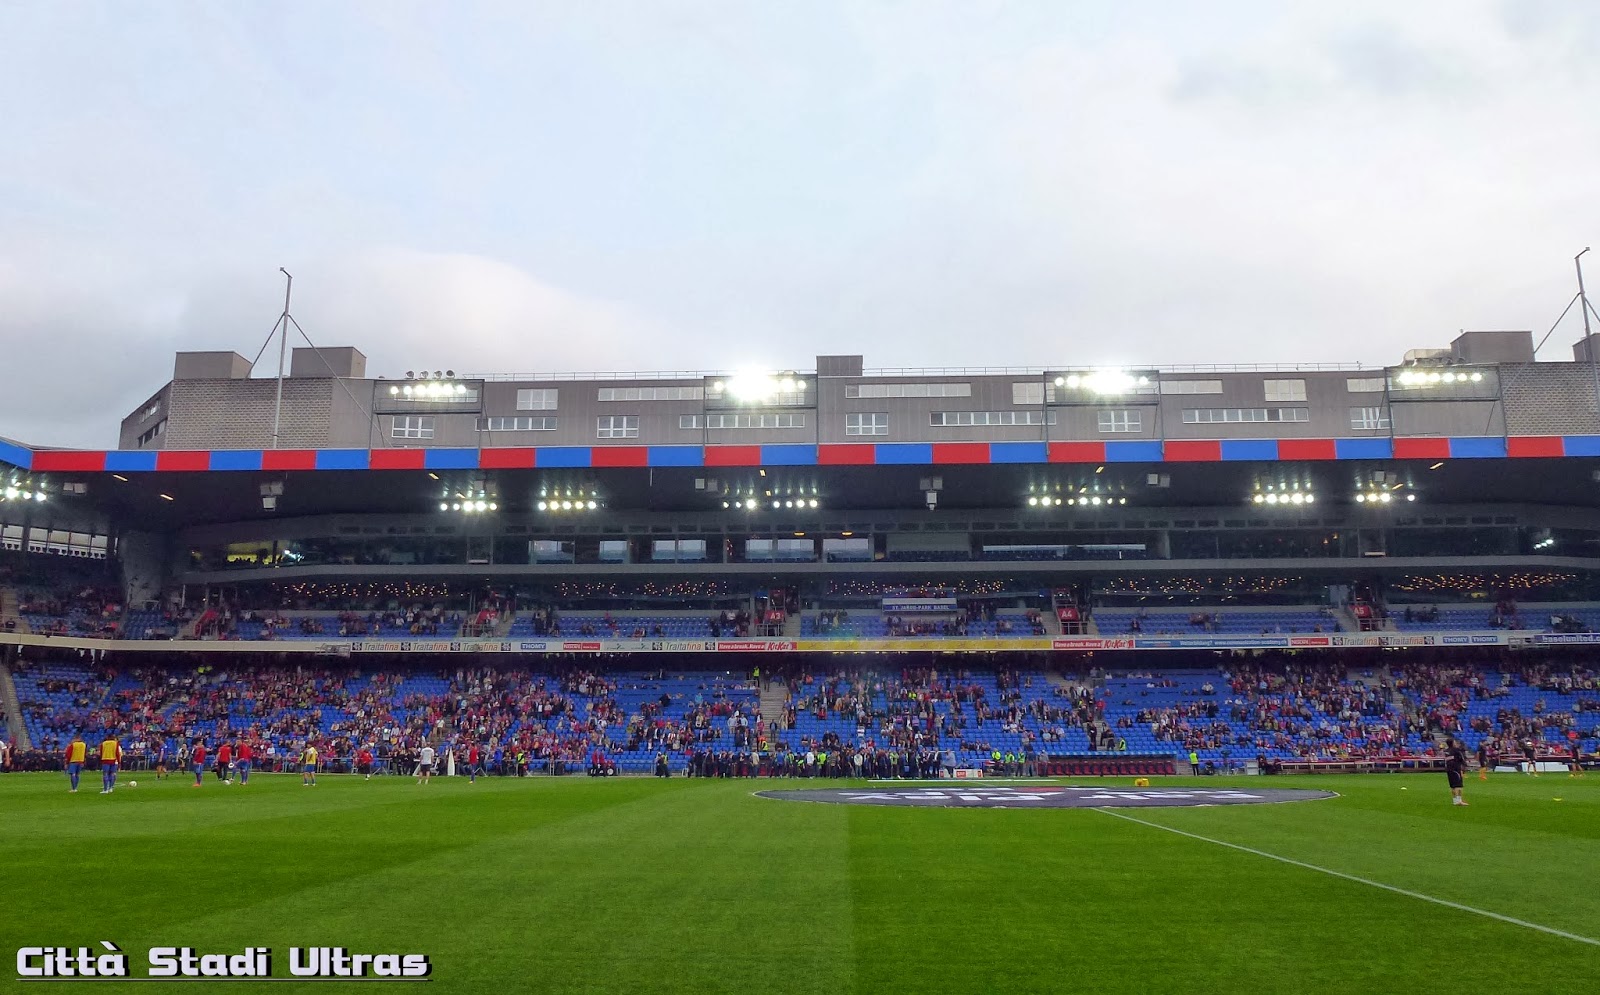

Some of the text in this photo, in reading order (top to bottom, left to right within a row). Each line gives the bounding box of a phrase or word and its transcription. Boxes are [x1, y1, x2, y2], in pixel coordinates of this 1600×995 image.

[770, 612, 781, 620] A3
[1104, 640, 1126, 648] KitKat
[1389, 637, 1424, 645] Traitafina
[364, 643, 399, 651] Traitafina
[413, 643, 448, 651] Traitafina
[463, 643, 499, 651] Traafina
[665, 642, 702, 650] Traitafina
[767, 641, 789, 650] KitKat
